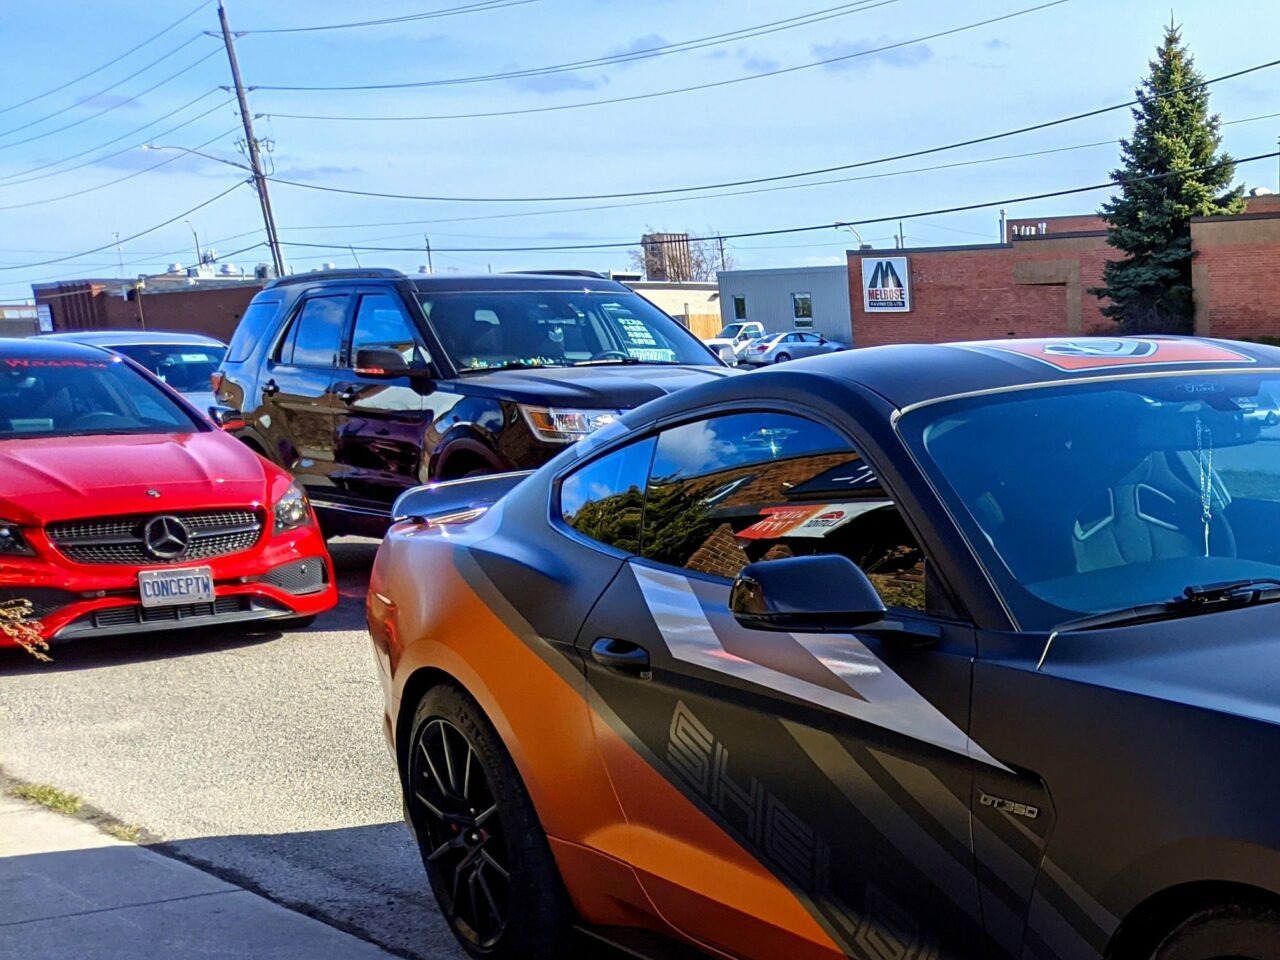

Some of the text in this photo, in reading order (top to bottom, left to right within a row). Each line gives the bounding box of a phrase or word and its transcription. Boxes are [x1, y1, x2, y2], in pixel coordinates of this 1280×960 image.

[868, 288, 905, 300] MELROSE
[143, 576, 211, 598] CONCEPTW
[979, 793, 1039, 819] GT350
